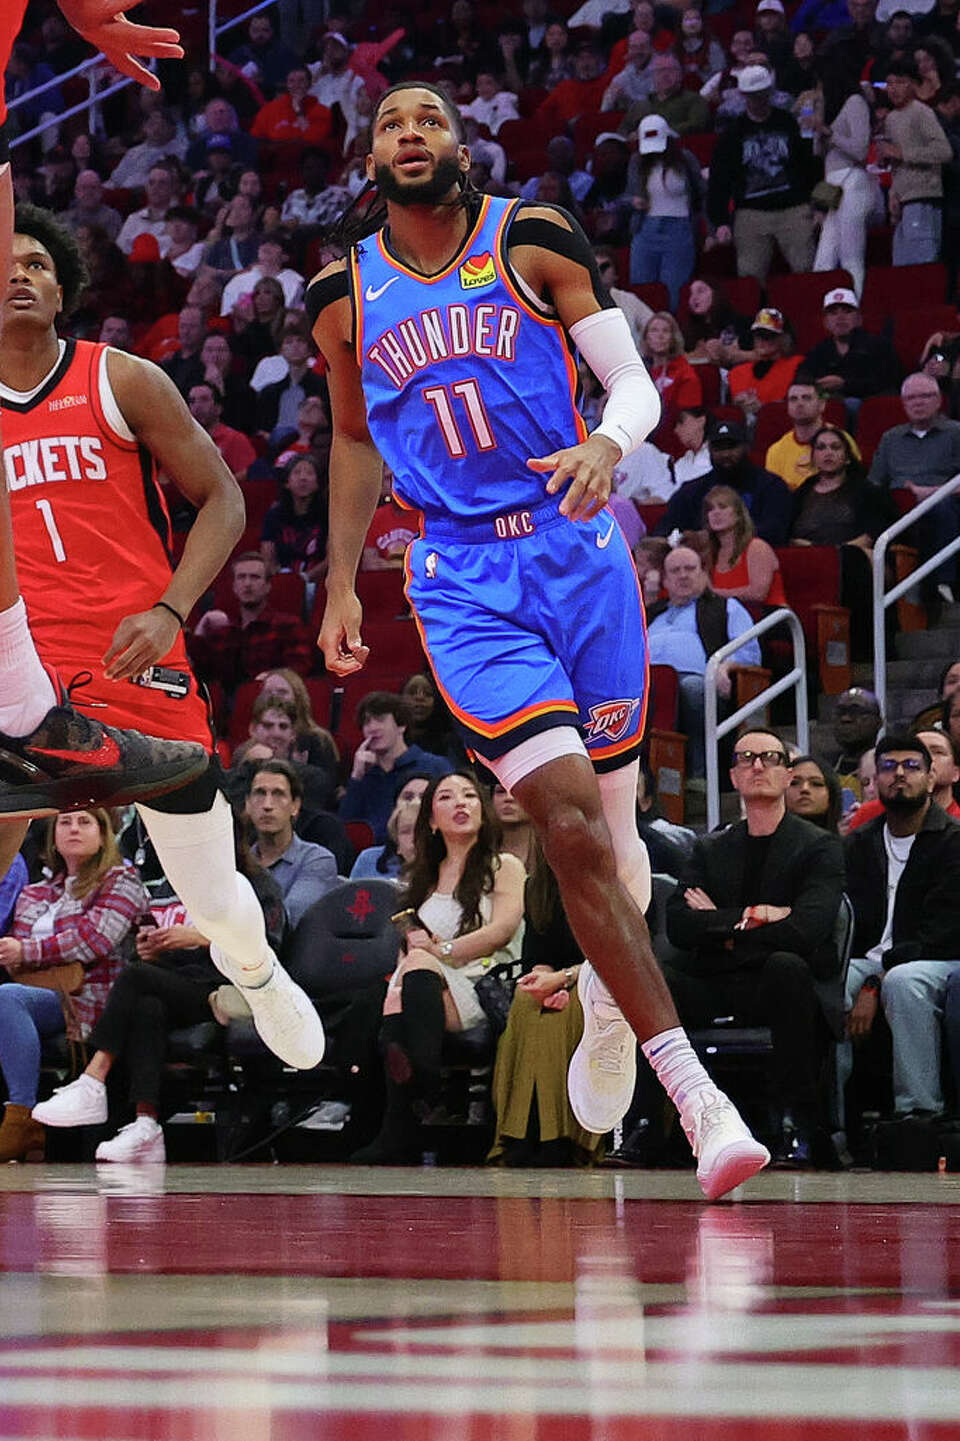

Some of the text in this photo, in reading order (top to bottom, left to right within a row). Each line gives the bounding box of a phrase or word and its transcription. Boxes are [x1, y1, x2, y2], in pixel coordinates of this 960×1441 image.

[368, 304, 520, 388] THUNDER
[424, 377, 496, 459] 11
[36, 499, 67, 562] 1
[495, 511, 534, 539] OKC
[592, 706, 626, 735] OKC
